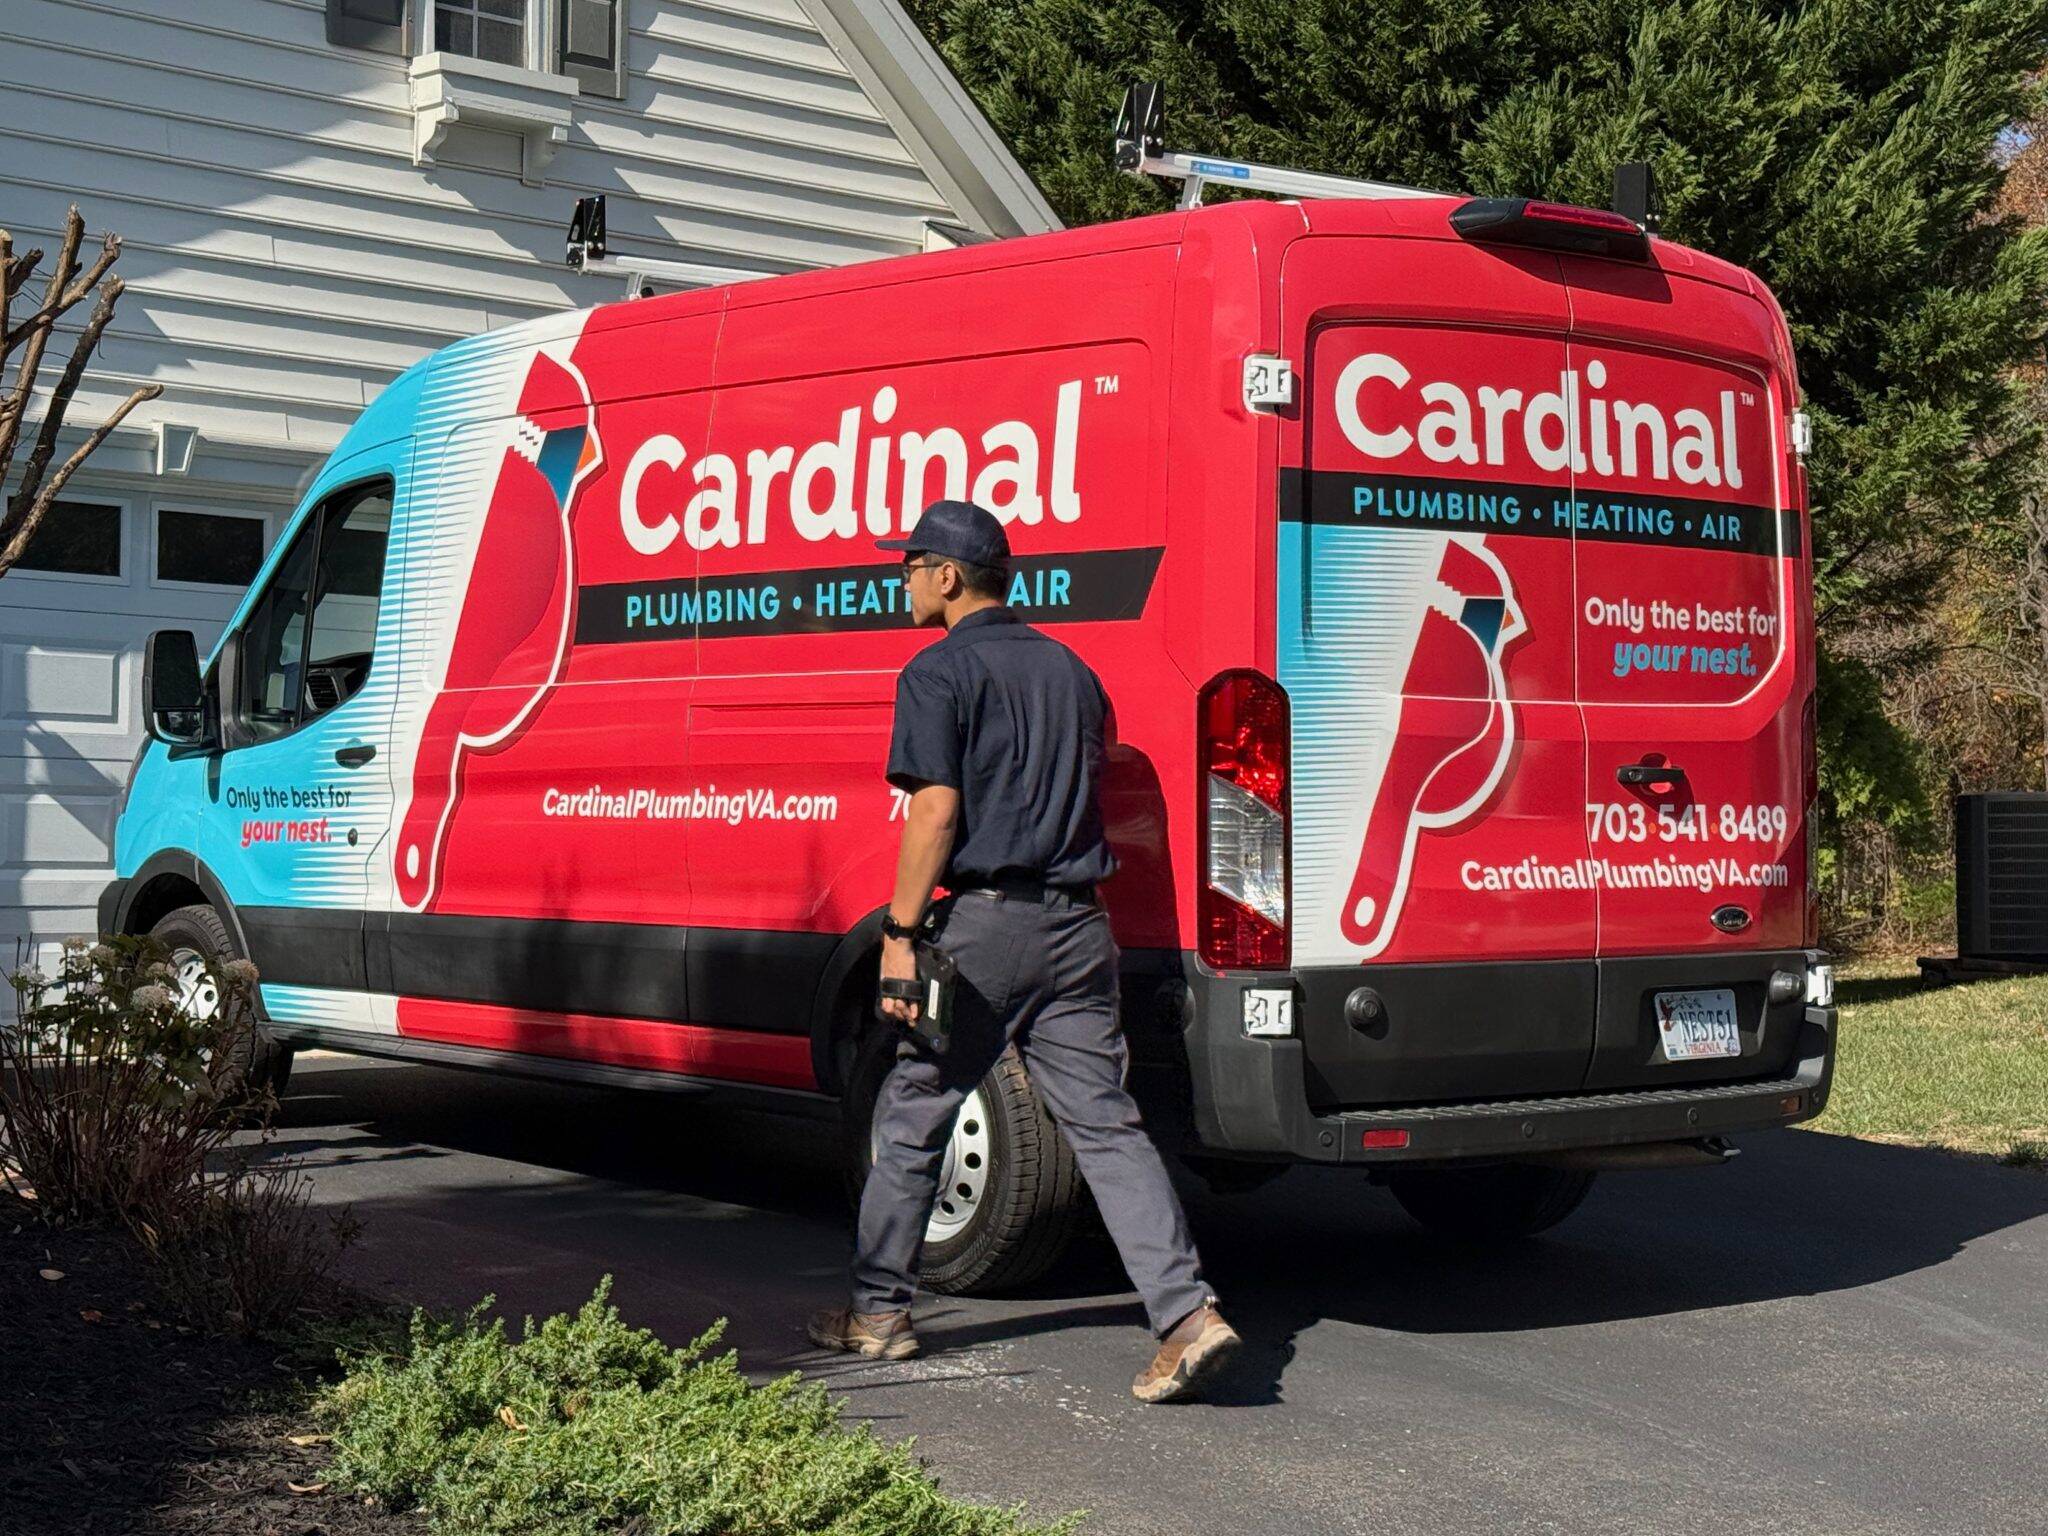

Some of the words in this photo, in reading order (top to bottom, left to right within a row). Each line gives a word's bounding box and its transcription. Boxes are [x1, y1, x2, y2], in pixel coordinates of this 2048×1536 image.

[1334, 353, 1743, 489] Cardinal
[620, 380, 1082, 555] Cardinal
[1353, 487, 1522, 524] PLUMBING
[1554, 500, 1673, 535] HEATING
[1701, 514, 1741, 541] AIR
[626, 586, 780, 628] PLUMBING
[816, 578, 912, 616] HEATI
[1006, 569, 1072, 607] AIR
[1585, 597, 1644, 634] Only
[1650, 600, 1690, 630] the
[1696, 603, 1744, 634] best
[1748, 606, 1776, 636] for
[1613, 642, 1686, 677] your
[1690, 642, 1757, 676] nest.
[226, 786, 260, 813] Only
[263, 786, 288, 808] the
[291, 785, 326, 808] best
[328, 784, 351, 808] for
[542, 784, 837, 826] CardinalPlumbingVA.com
[241, 820, 284, 848] your
[287, 816, 332, 842] nest.
[1461, 854, 1788, 893] CardinalPlumbingVA.com
[1679, 1009, 1734, 1042] NEST51
